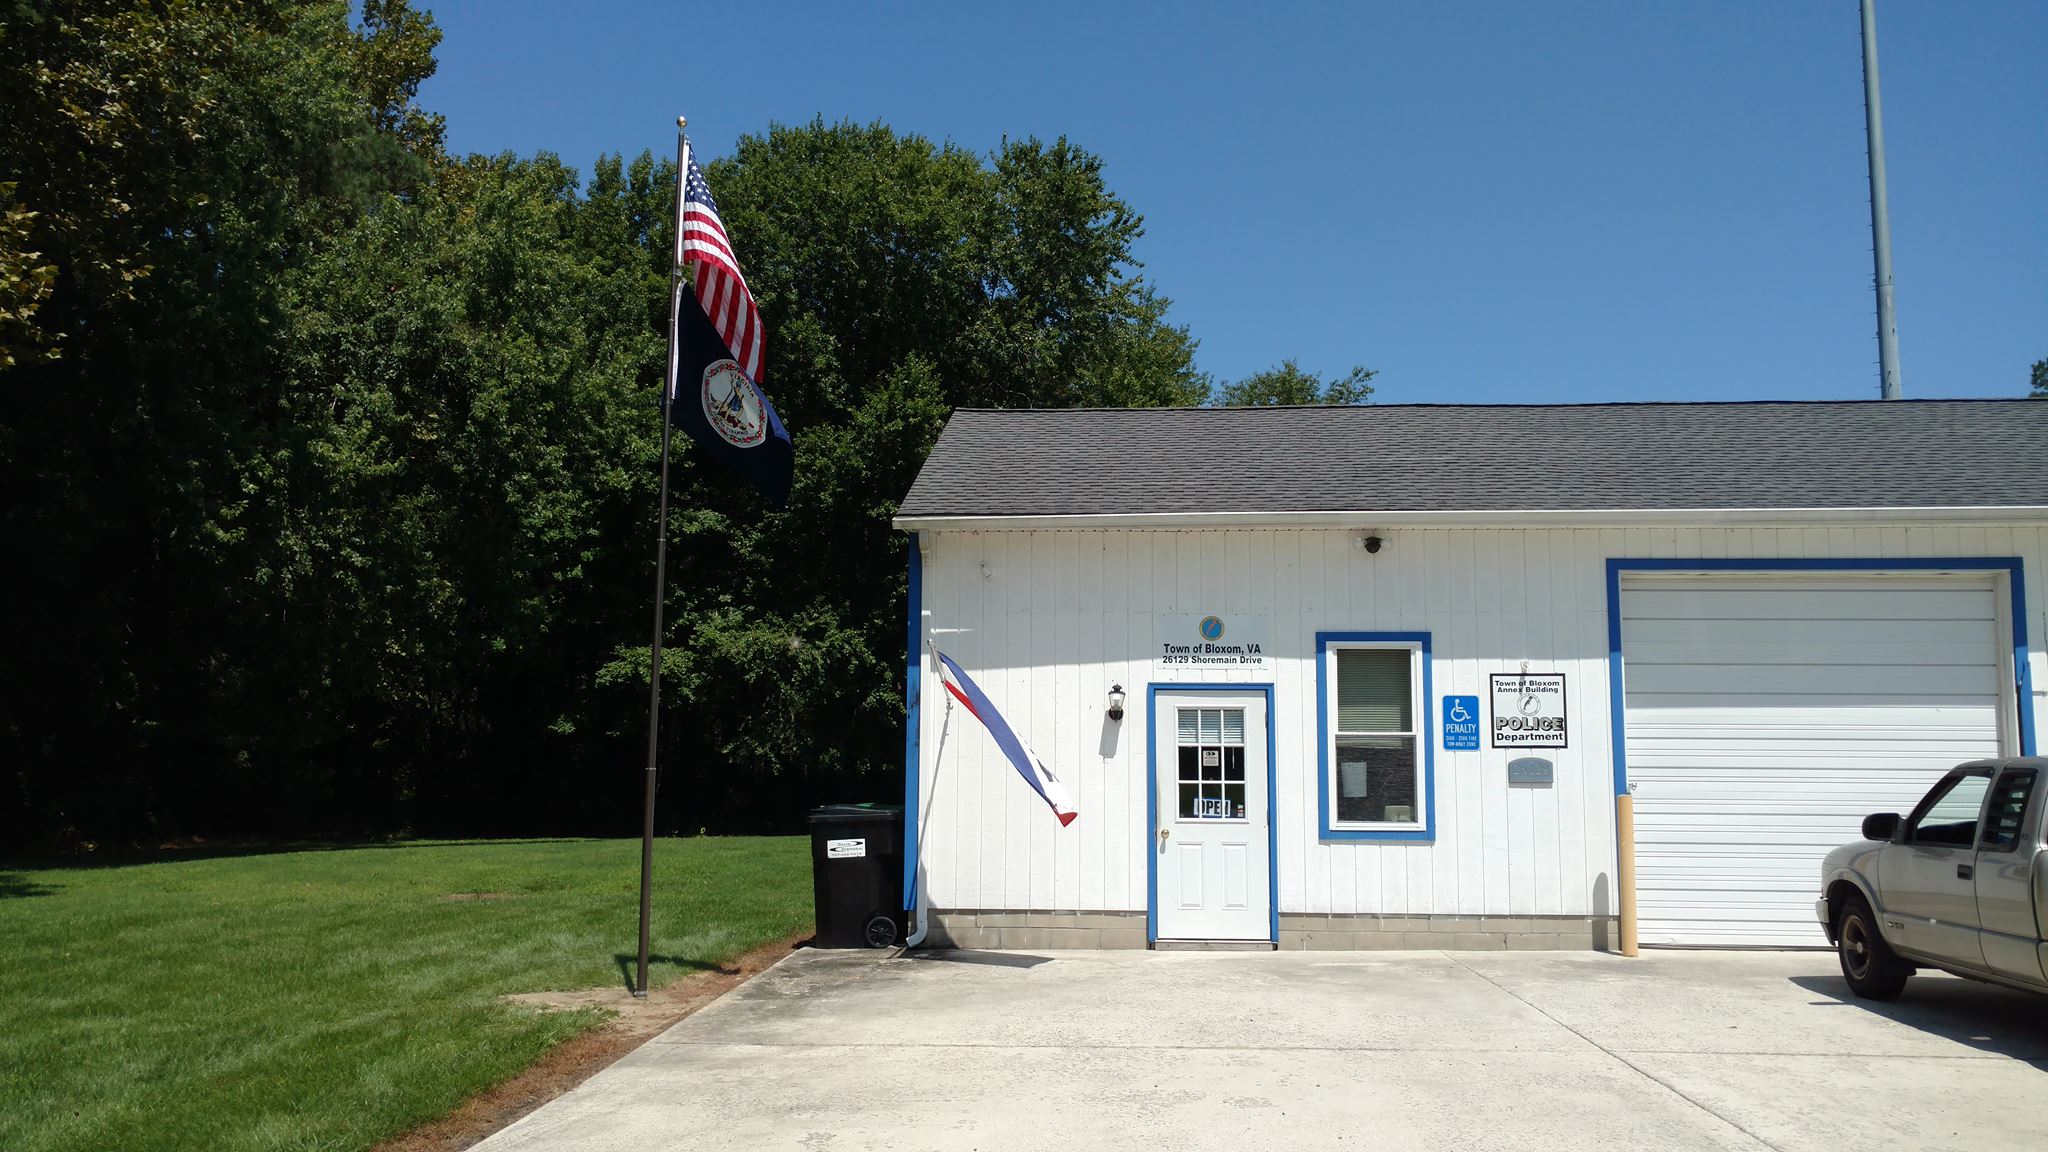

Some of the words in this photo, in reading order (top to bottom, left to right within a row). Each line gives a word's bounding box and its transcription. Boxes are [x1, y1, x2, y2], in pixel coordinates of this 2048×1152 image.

[730, 373, 754, 398] VIRGINIA
[1164, 644, 1190, 654] Town
[1193, 644, 1202, 654] of
[1205, 644, 1244, 655] Bloxom,
[1247, 644, 1261, 654] VA
[1163, 656, 1188, 664] 26129
[1191, 656, 1237, 664] Shoremain
[1240, 656, 1262, 664] Drive
[1446, 723, 1476, 733] PENALTY
[1496, 717, 1564, 731] POLICE
[1496, 733, 1563, 742] Department
